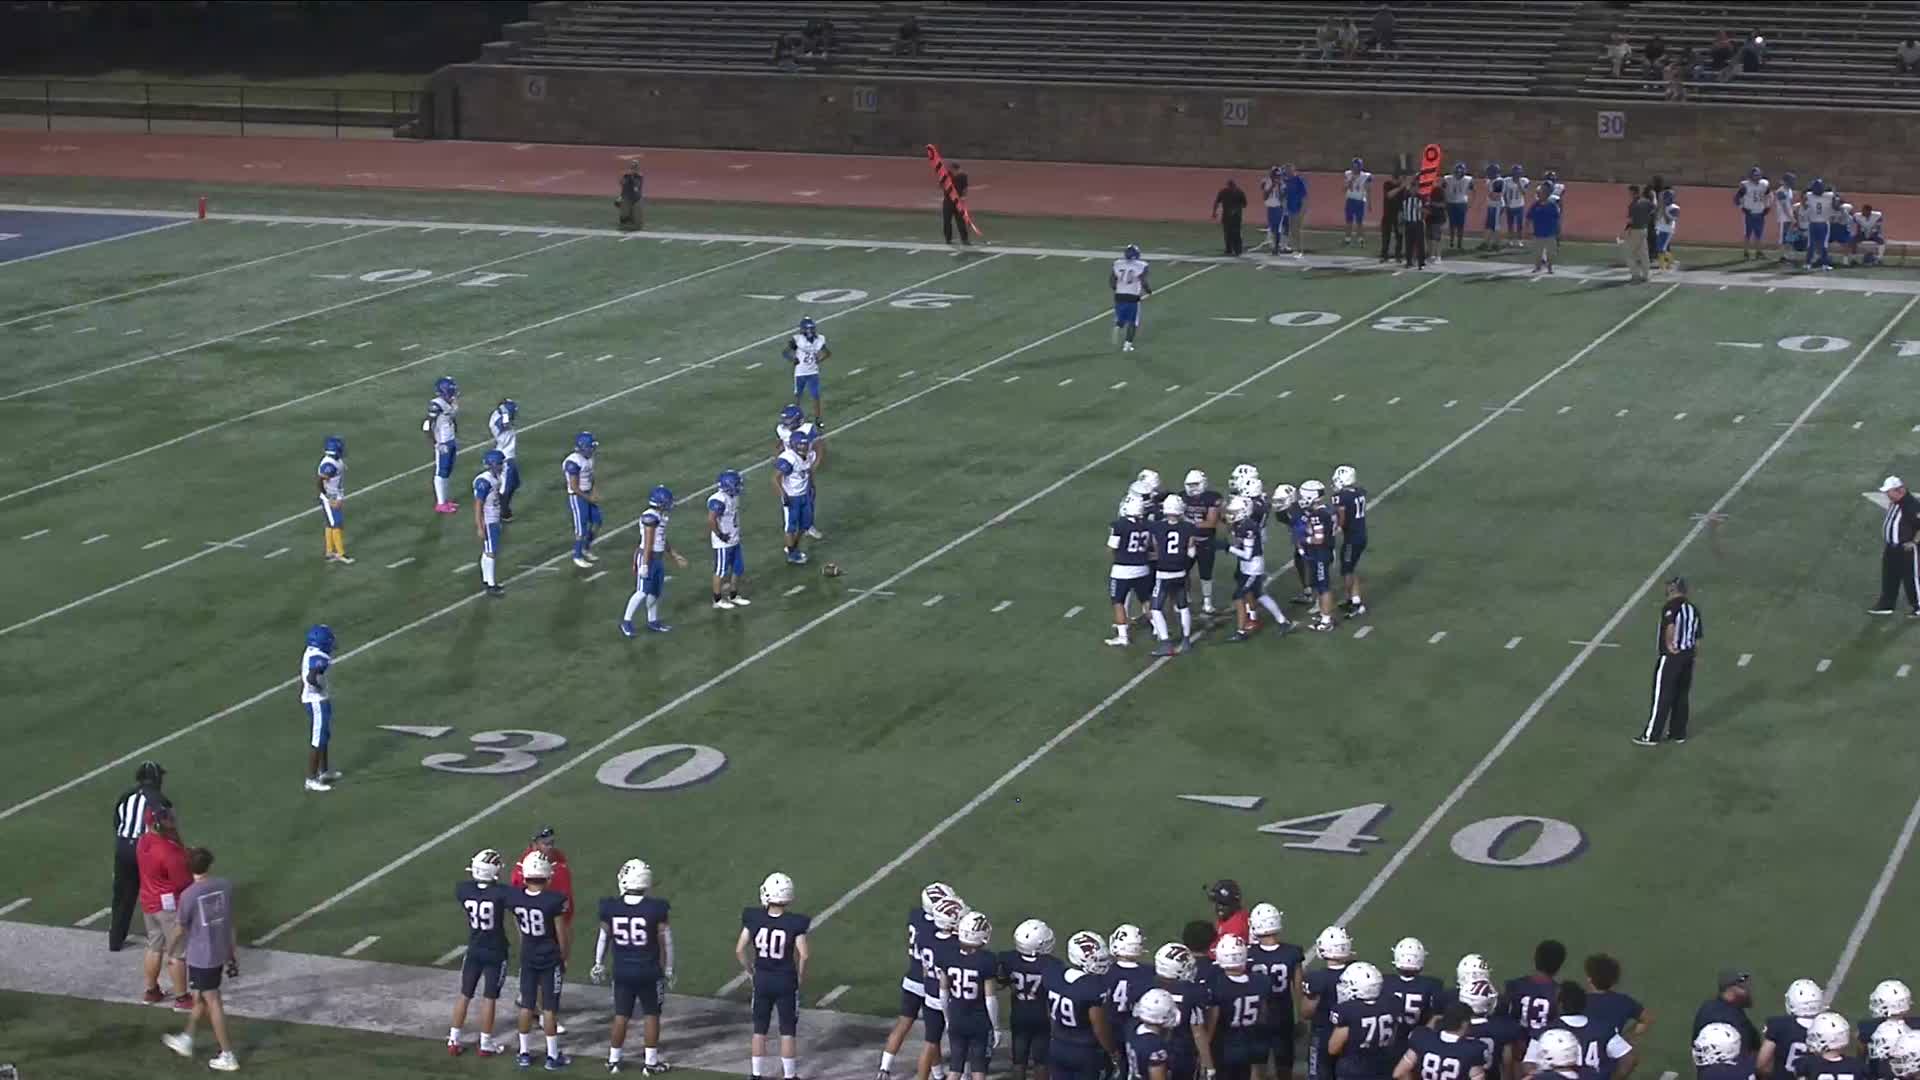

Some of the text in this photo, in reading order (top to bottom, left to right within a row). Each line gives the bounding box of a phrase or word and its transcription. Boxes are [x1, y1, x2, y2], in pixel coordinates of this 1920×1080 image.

[857, 88, 878, 108] 10
[1224, 102, 1247, 120] 20
[1600, 115, 1623, 134] 30
[1355, 496, 1366, 519] 17
[1127, 531, 1150, 553] 63
[1167, 531, 1180, 554] 2
[464, 900, 495, 930] 39
[514, 906, 546, 937] 38
[612, 916, 648, 946] 56
[754, 927, 786, 959] 40
[947, 966, 979, 1000] 35
[1048, 990, 1077, 1027] 79
[1231, 995, 1260, 1027] 15
[1520, 996, 1550, 1030] 13
[1360, 1013, 1394, 1049] 76
[1422, 1052, 1460, 1080] 82
